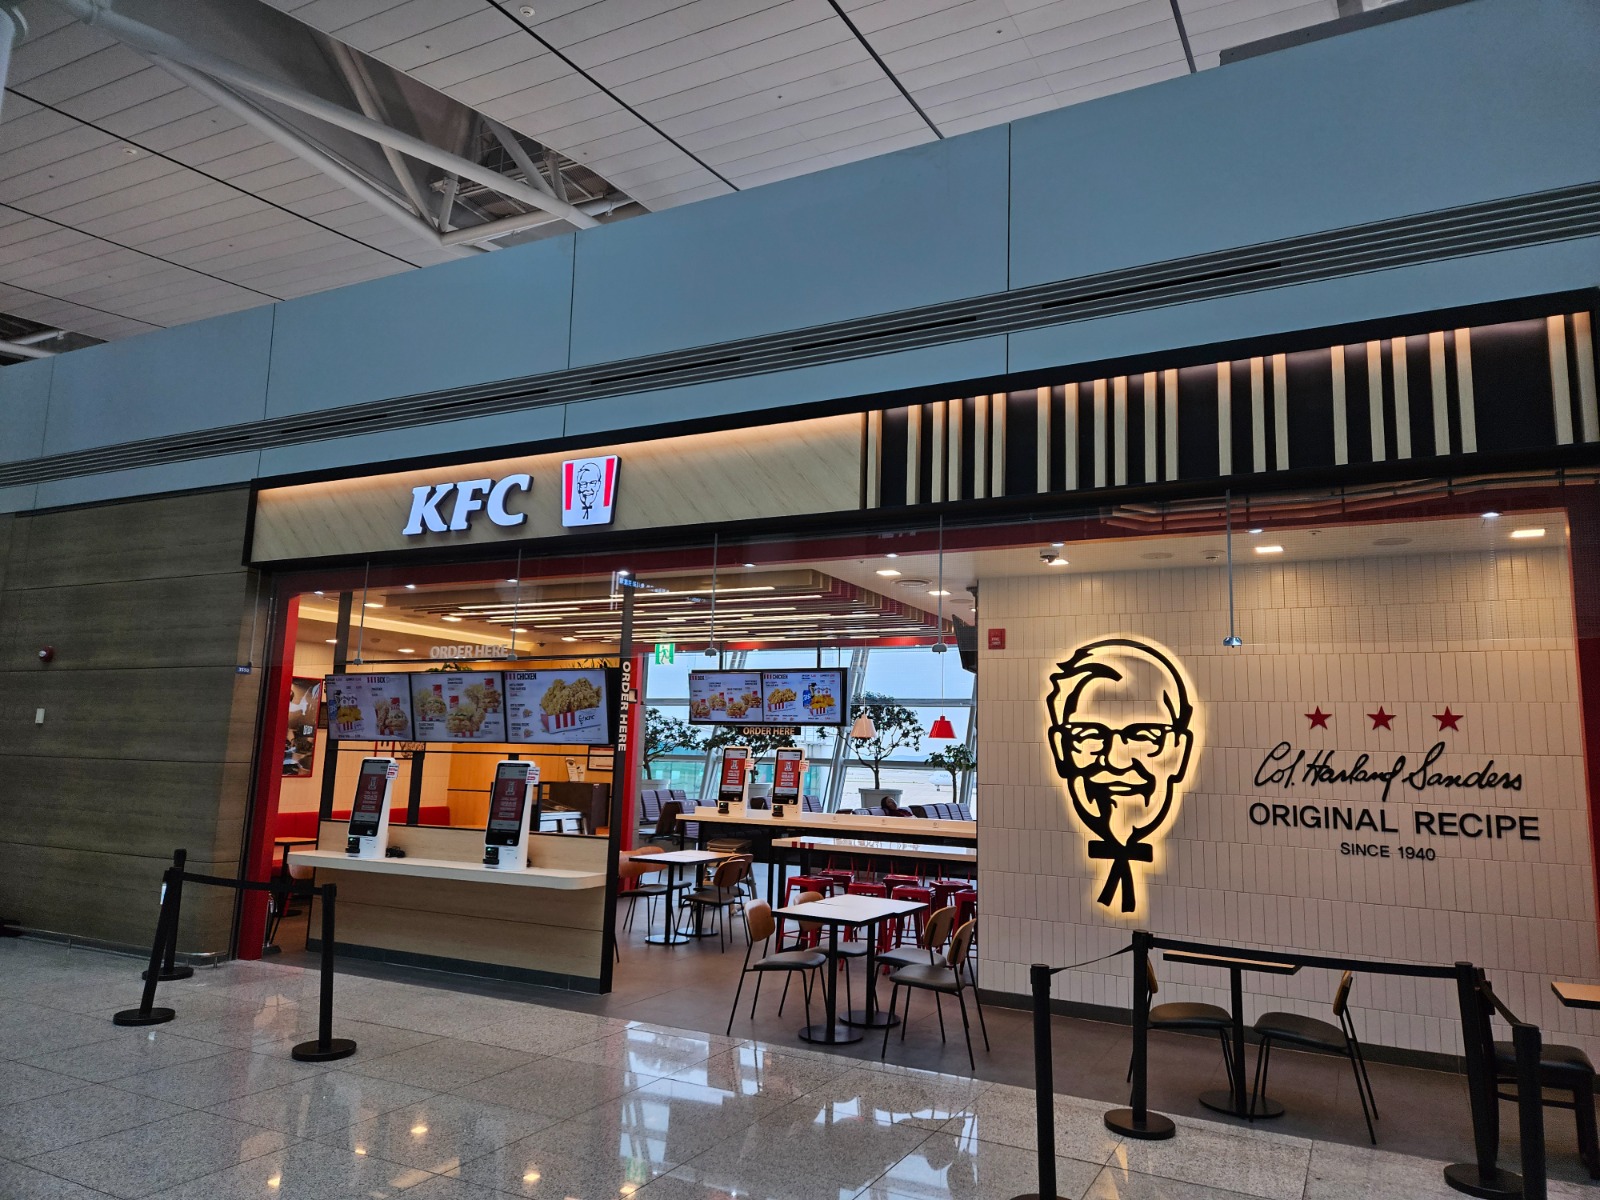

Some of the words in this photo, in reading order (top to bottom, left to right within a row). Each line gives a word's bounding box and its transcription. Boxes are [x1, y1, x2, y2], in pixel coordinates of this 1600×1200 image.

[402, 474, 533, 536] KFC
[430, 645, 473, 659] ORDER
[475, 644, 508, 658] HERE
[516, 673, 537, 681] CHICKEN
[620, 661, 631, 711] ORDER
[617, 713, 628, 752] HERE
[743, 727, 771, 736] ORDER
[773, 727, 795, 736] HERE
[1254, 741, 1305, 789] Col.
[1302, 750, 1406, 802] Harland
[1402, 741, 1522, 791] Sanders
[1249, 802, 1399, 833] ORIGINAL
[1414, 811, 1541, 841] RECIPE
[1340, 842, 1390, 858] SINCE
[1398, 846, 1436, 861] 1940
